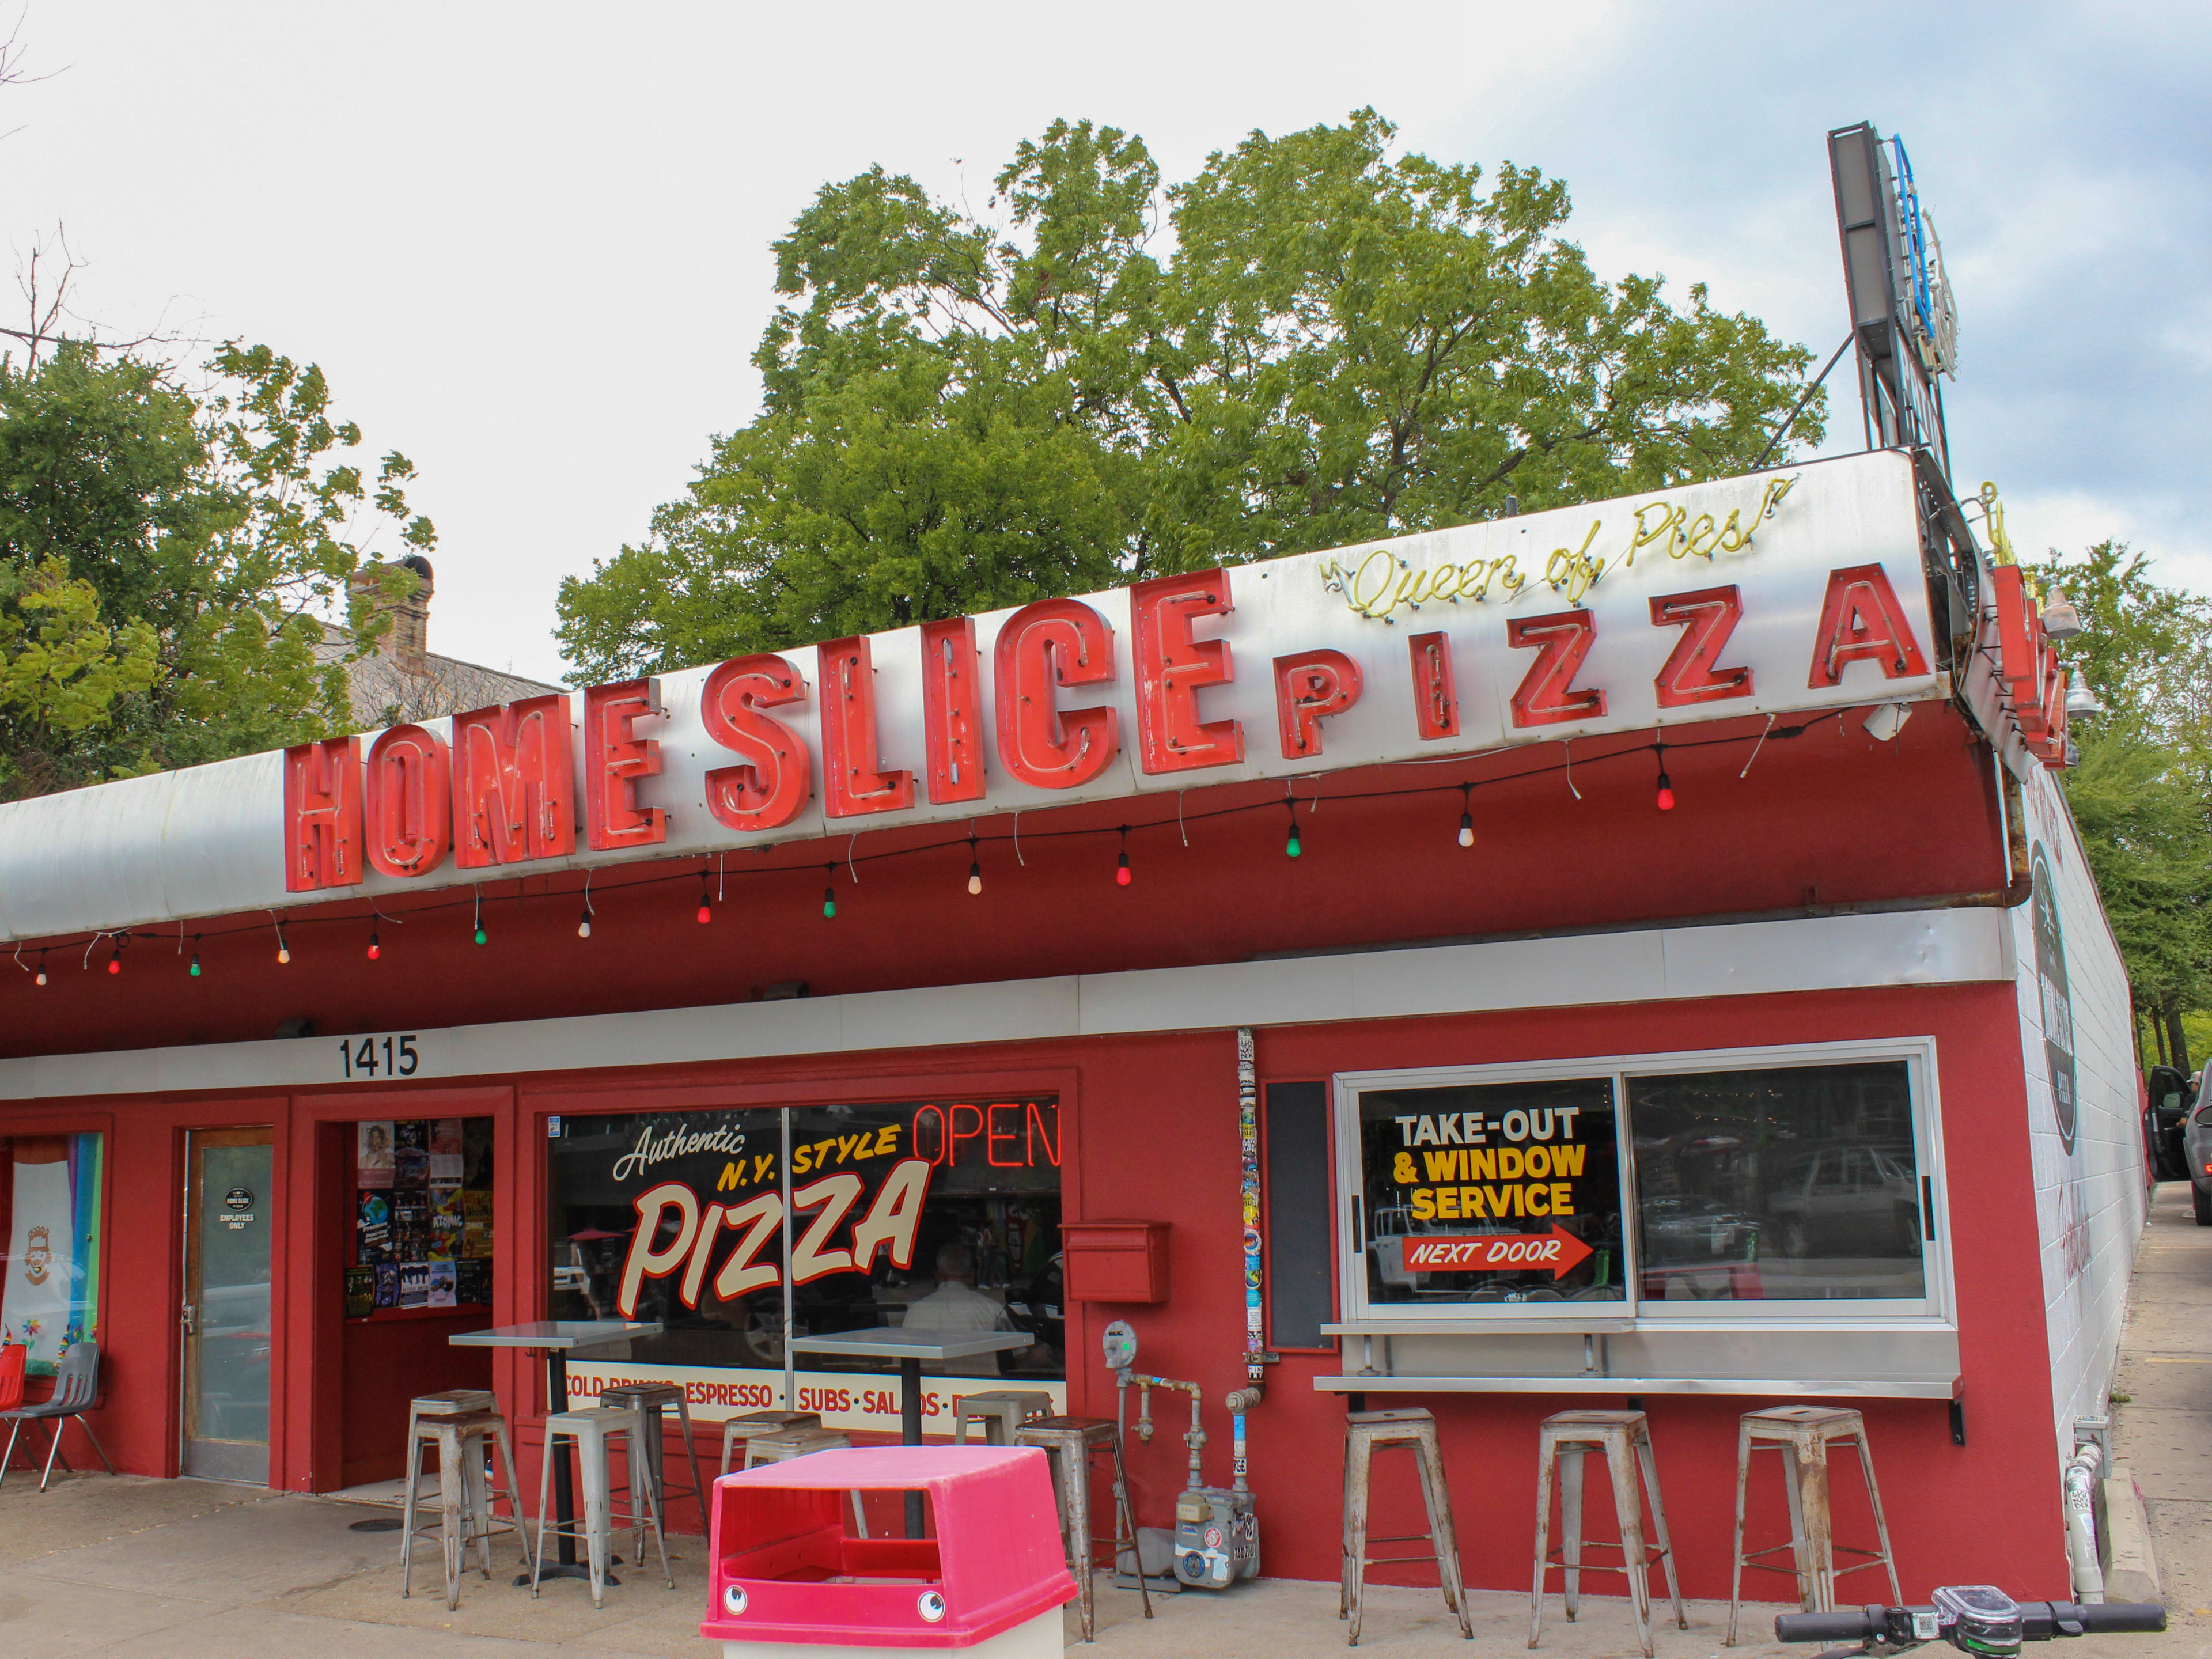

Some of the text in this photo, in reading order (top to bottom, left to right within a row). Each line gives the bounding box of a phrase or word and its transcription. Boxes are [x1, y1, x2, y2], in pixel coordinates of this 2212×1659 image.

[1348, 550, 1525, 618] Queen
[1546, 520, 1603, 605] of
[285, 562, 1930, 893] HOME SLICE PIZZA
[340, 1035, 418, 1078] 1415
[912, 1103, 1061, 1167] OPEN
[1395, 1107, 1579, 1146] TAKE-OUT
[613, 1123, 745, 1181] Authentic
[717, 1124, 902, 1192] N.Y. STYLE
[1393, 1145, 1585, 1183] & WINDOW
[433, 1215, 463, 1229] ATOMIC
[1411, 1183, 1574, 1220] SERVICE
[616, 1157, 933, 1320] PIZZA
[1410, 1239, 1562, 1264] NEXT DOOR
[685, 1382, 772, 1407] ESPRESSO
[798, 1388, 851, 1412] SUBS
